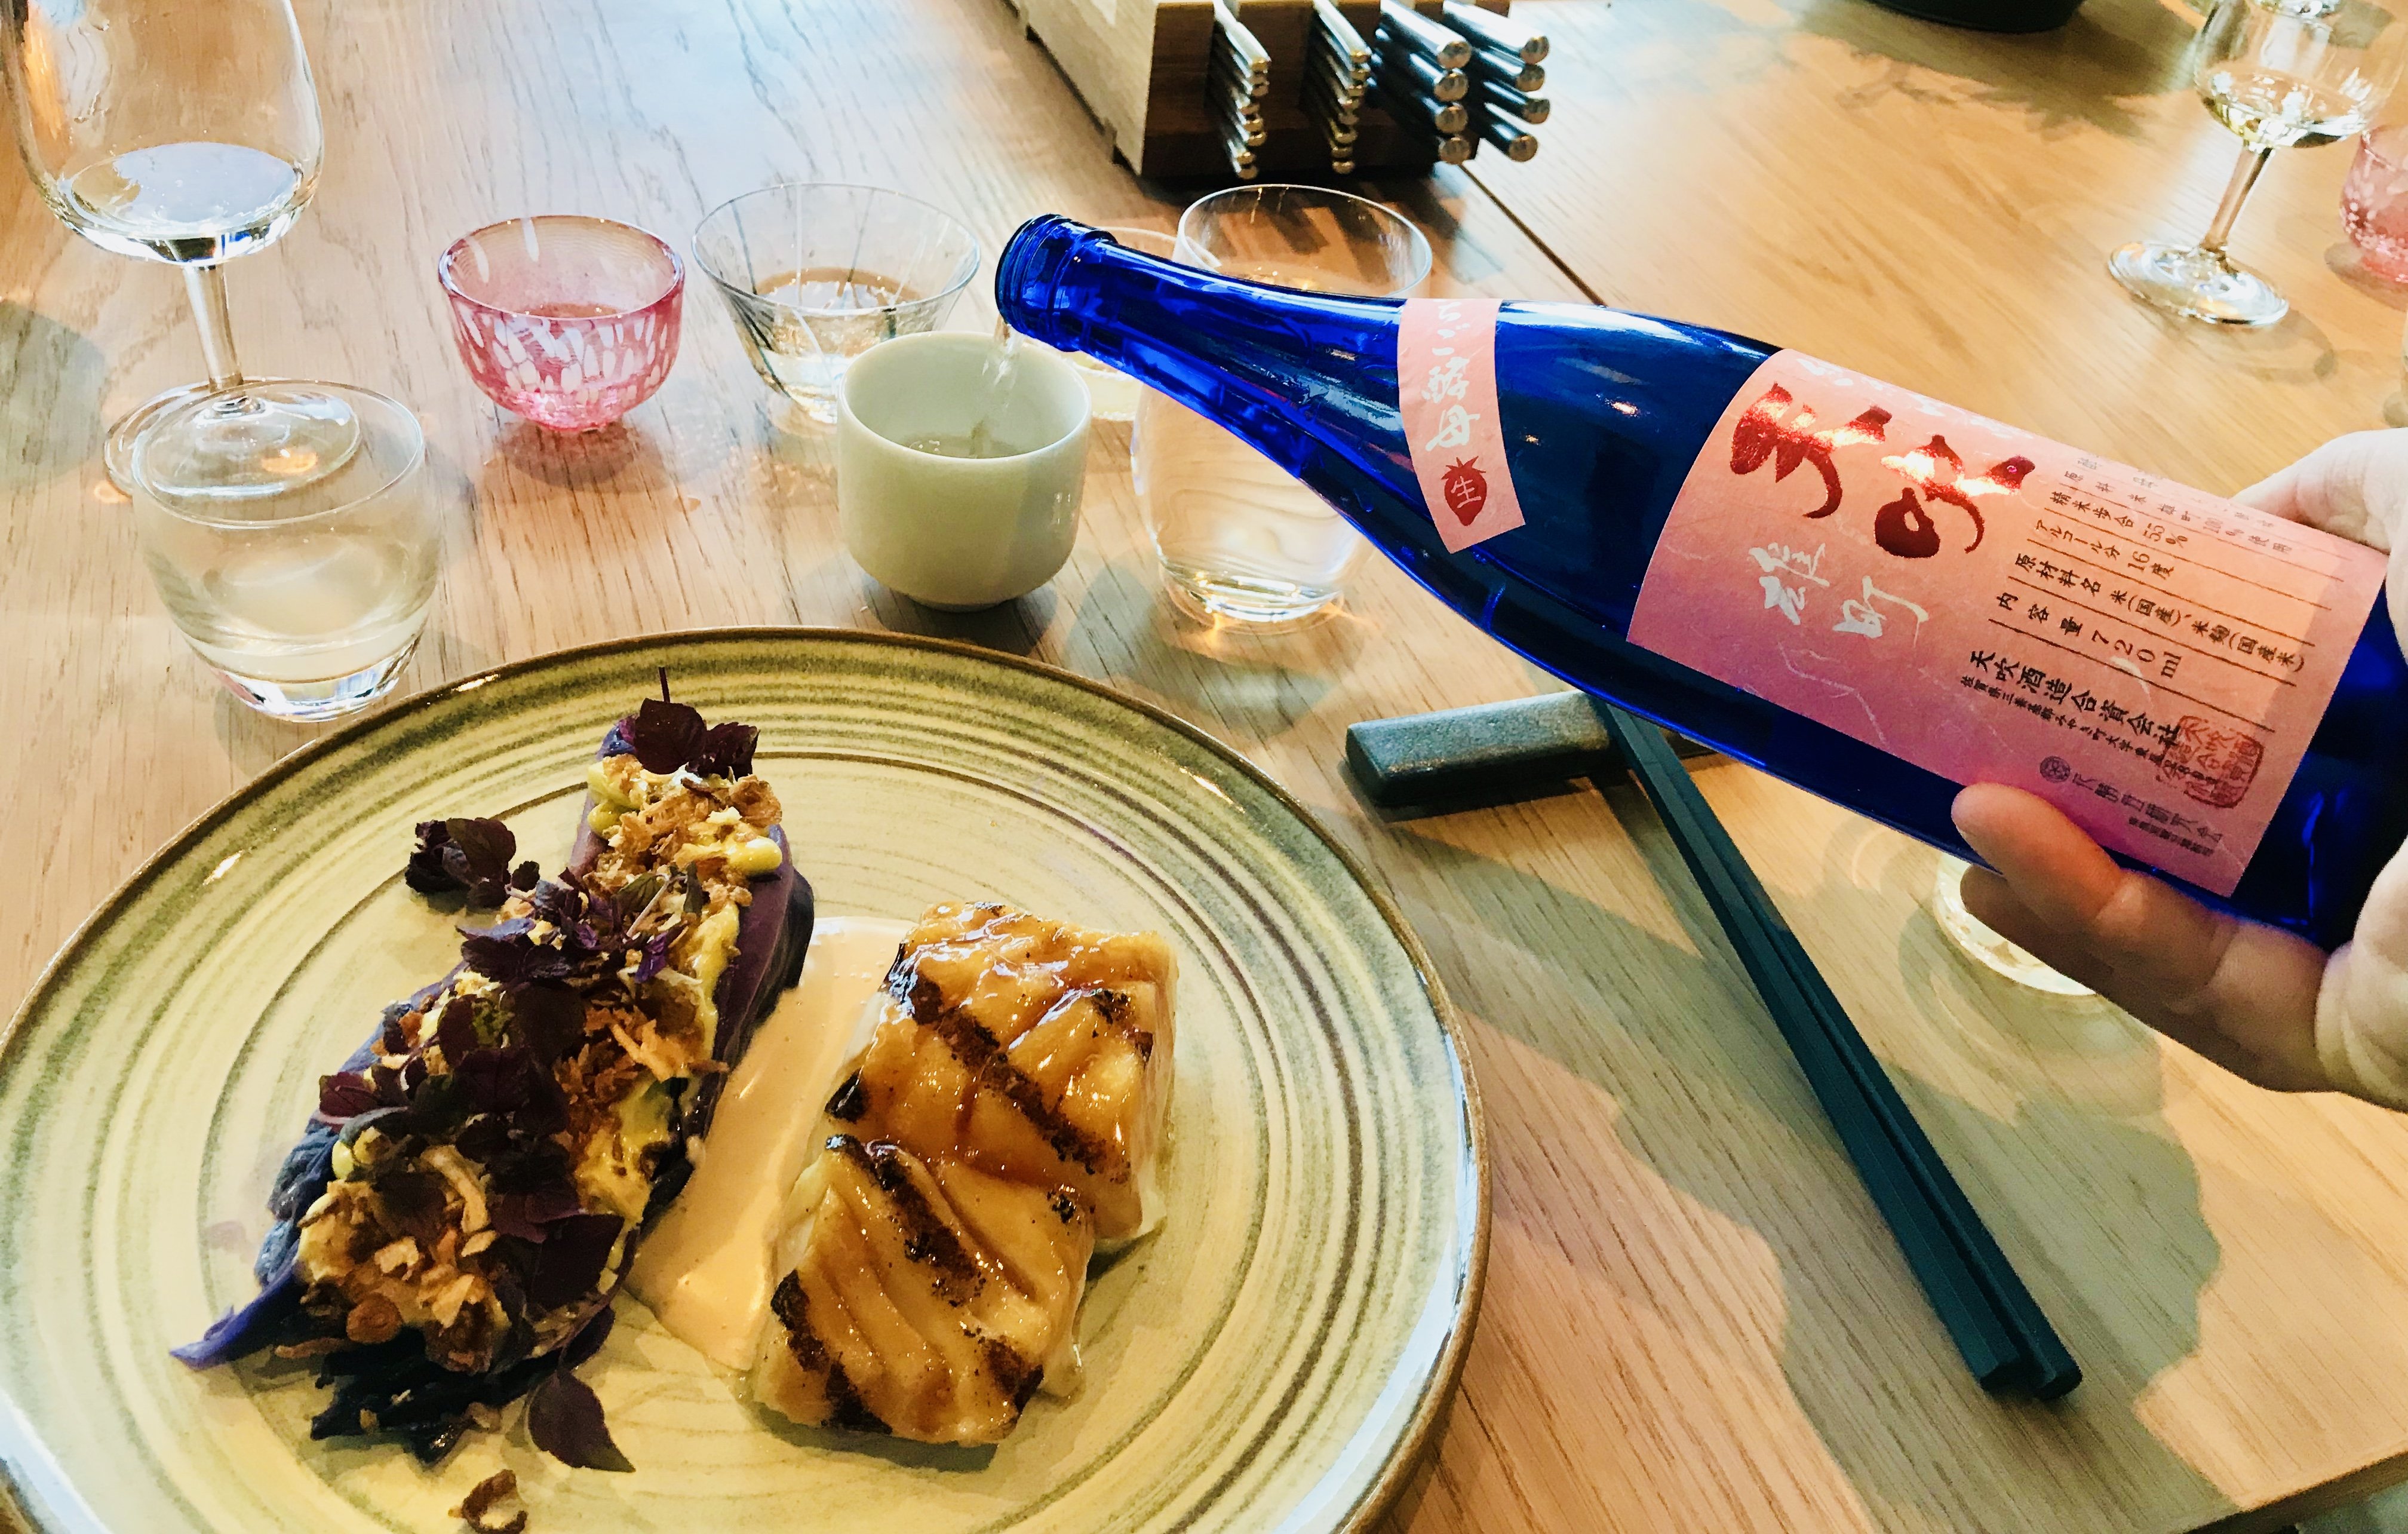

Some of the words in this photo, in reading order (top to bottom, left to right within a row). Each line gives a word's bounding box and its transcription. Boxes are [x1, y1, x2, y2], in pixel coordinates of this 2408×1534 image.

[1421, 299, 1481, 452] ちご酵母
[1450, 476, 1482, 508] 生
[2034, 520, 2121, 560] アルコール分
[2014, 553, 2102, 598] 原材料名
[1970, 649, 2182, 748] 天吹酒造合資会社
